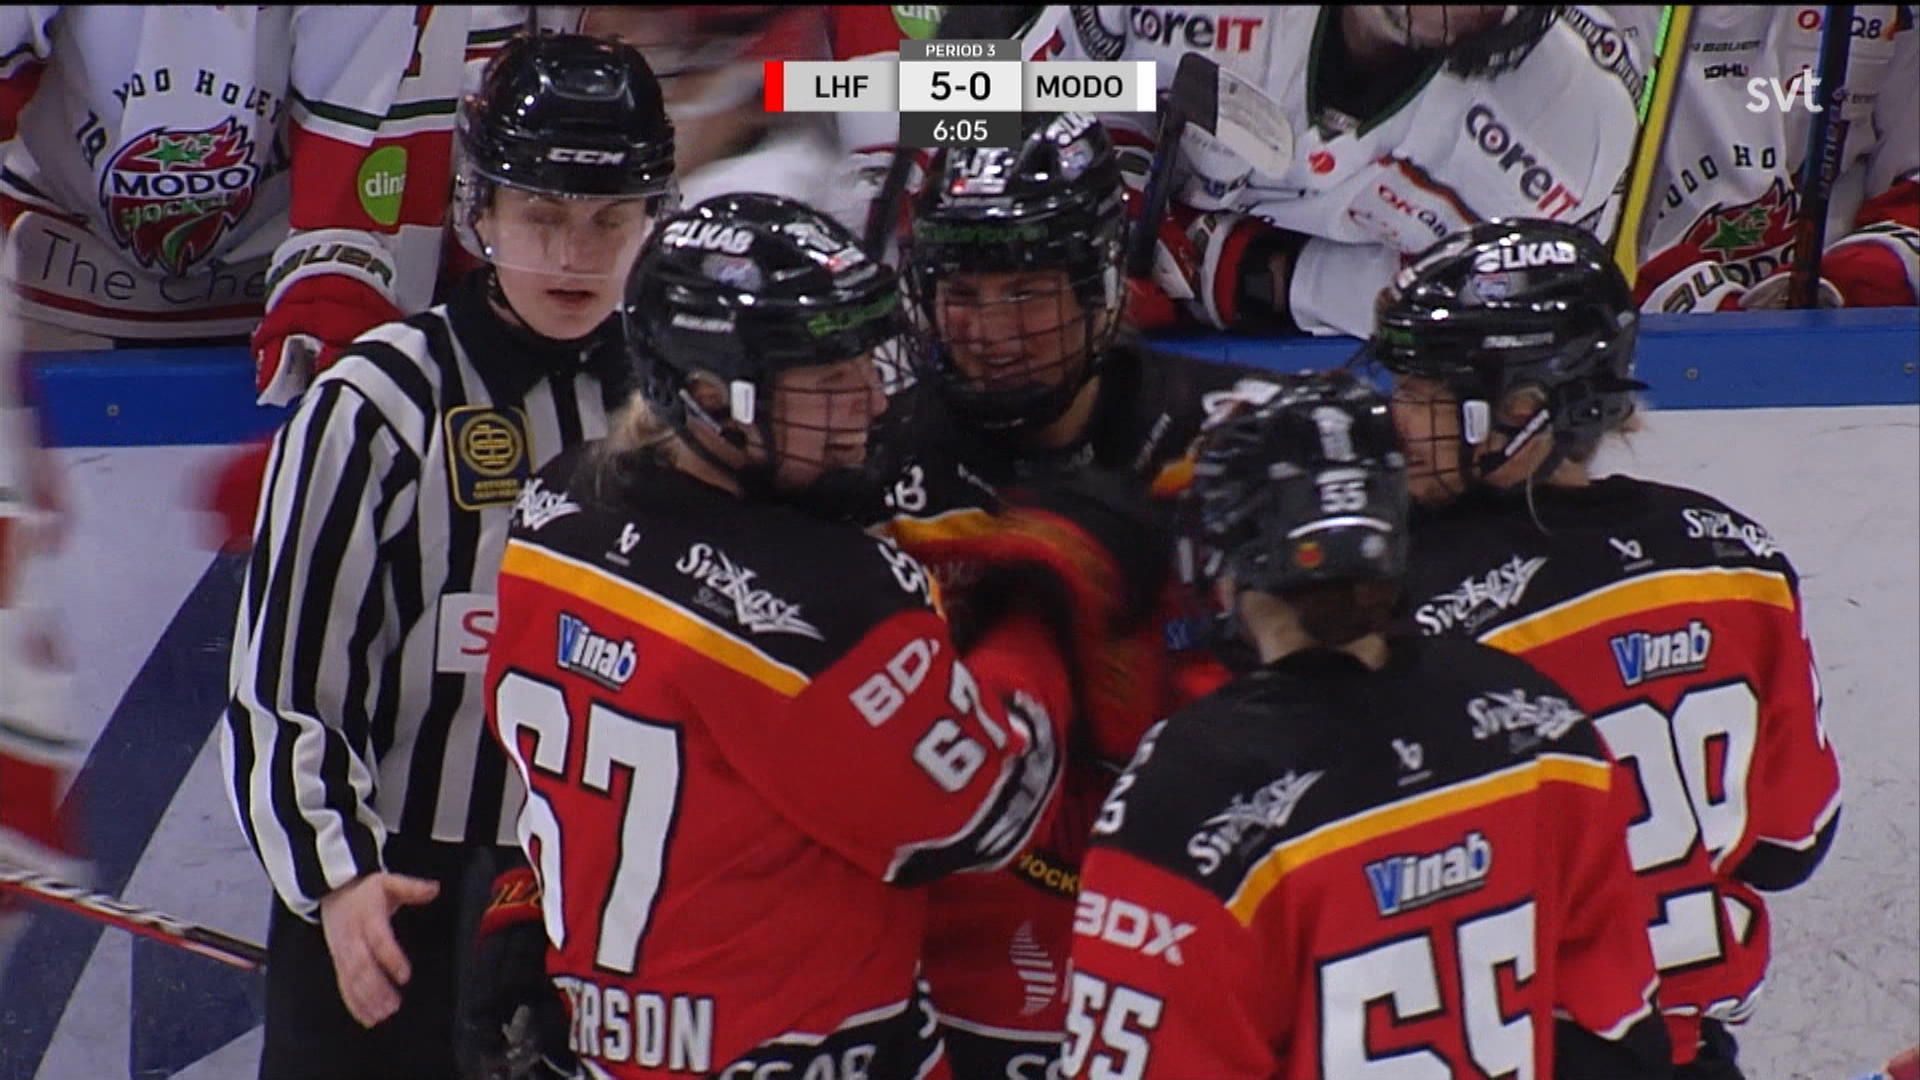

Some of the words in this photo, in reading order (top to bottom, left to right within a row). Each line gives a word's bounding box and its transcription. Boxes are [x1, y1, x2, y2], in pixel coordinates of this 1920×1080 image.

[113, 167, 250, 197] MODO
[548, 147, 624, 165] CCM
[1466, 104, 1582, 219] coreIT
[42, 228, 137, 300] The
[685, 220, 754, 254] LKAB
[1502, 241, 1577, 269] LKAB
[557, 611, 638, 684] Vinab
[1610, 621, 1713, 687] Vinab
[495, 664, 681, 975] 67
[1365, 832, 1492, 917] Vinab
[1072, 890, 1196, 967] BDX
[1061, 969, 1164, 1080] 55
